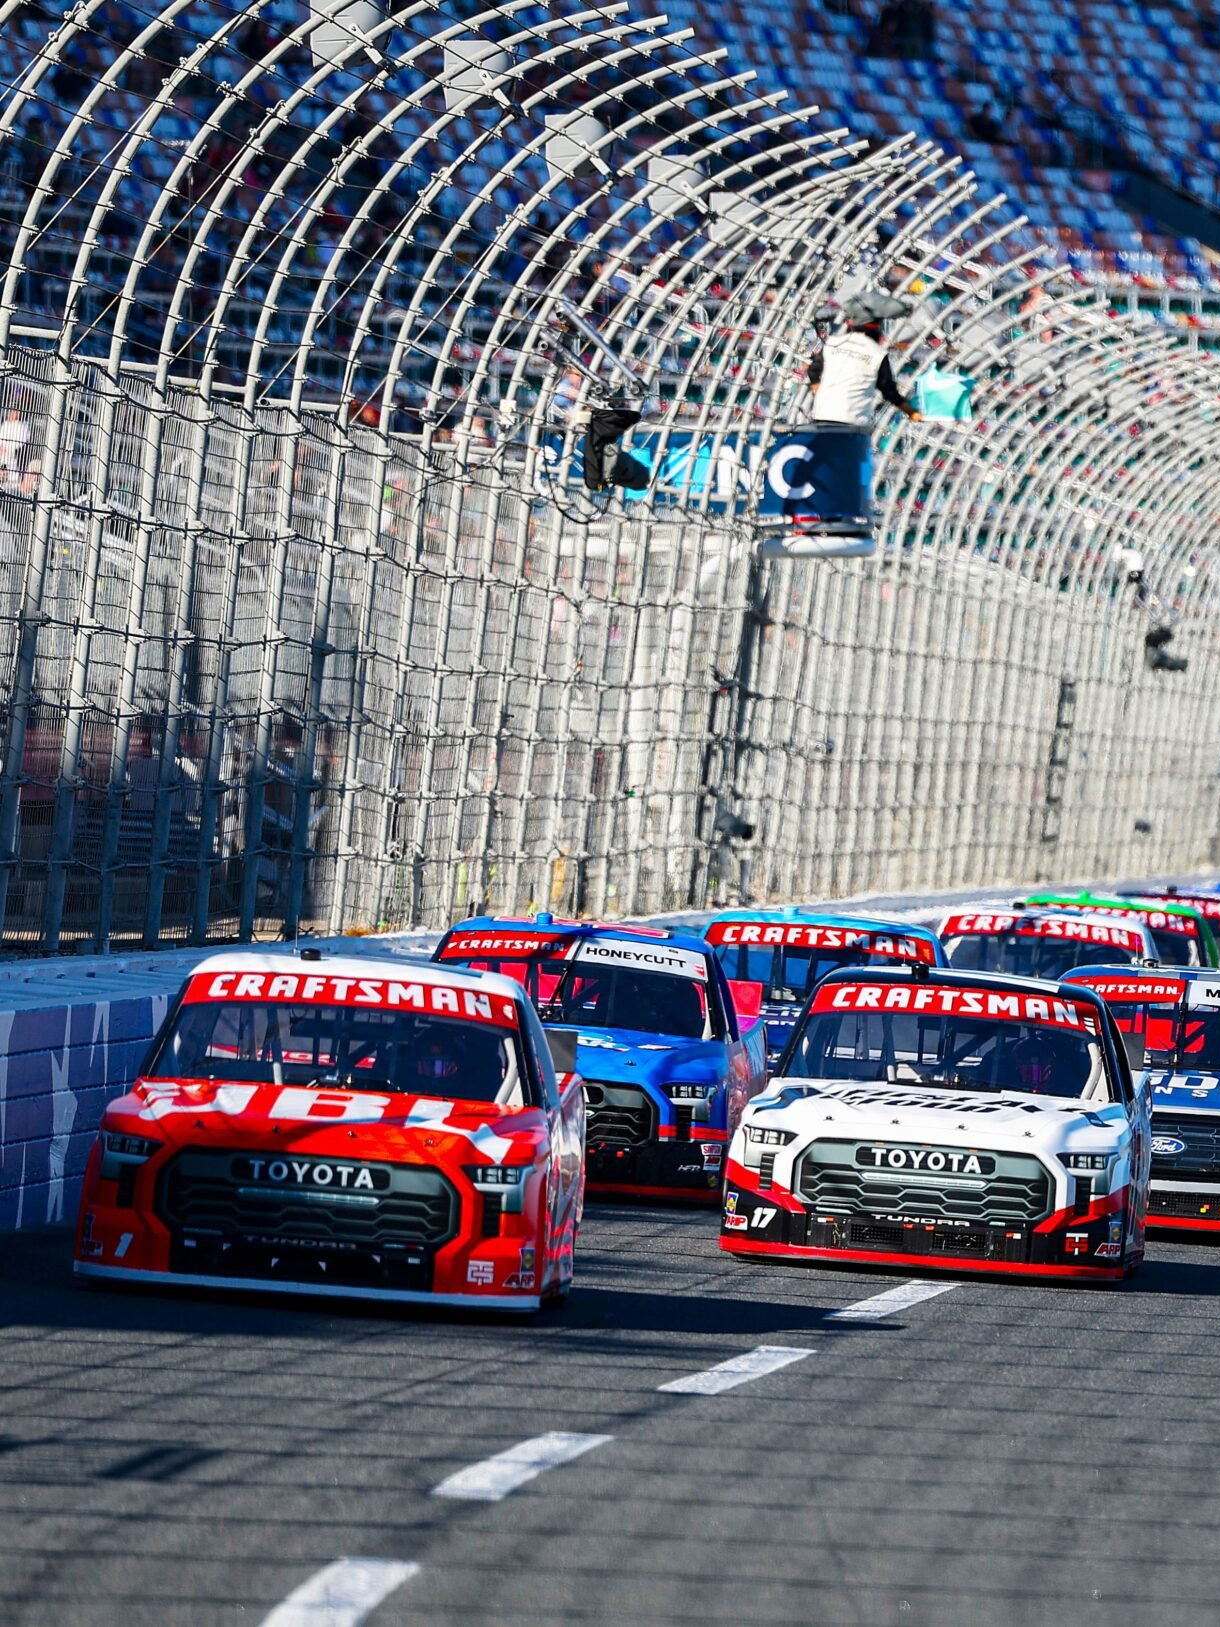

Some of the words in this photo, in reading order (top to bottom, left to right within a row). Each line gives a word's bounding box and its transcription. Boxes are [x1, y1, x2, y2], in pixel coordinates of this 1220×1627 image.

[722, 925, 917, 958] CRAFTSMAN
[958, 914, 1130, 946] CRAFTSMAN
[458, 939, 566, 952] CRAFTSMAN
[586, 946, 686, 969] HONEYCUTT
[208, 973, 492, 1019] CRAFTSMAN
[832, 986, 1078, 1026] CRAFTSMAN
[250, 1159, 374, 1189] TOYOTA
[871, 1148, 982, 1175] TOYOTA
[750, 1207, 777, 1228] 17
[871, 1213, 971, 1227] TUNDRA
[114, 1232, 134, 1258] 1
[242, 1233, 357, 1251] TUNDRA
